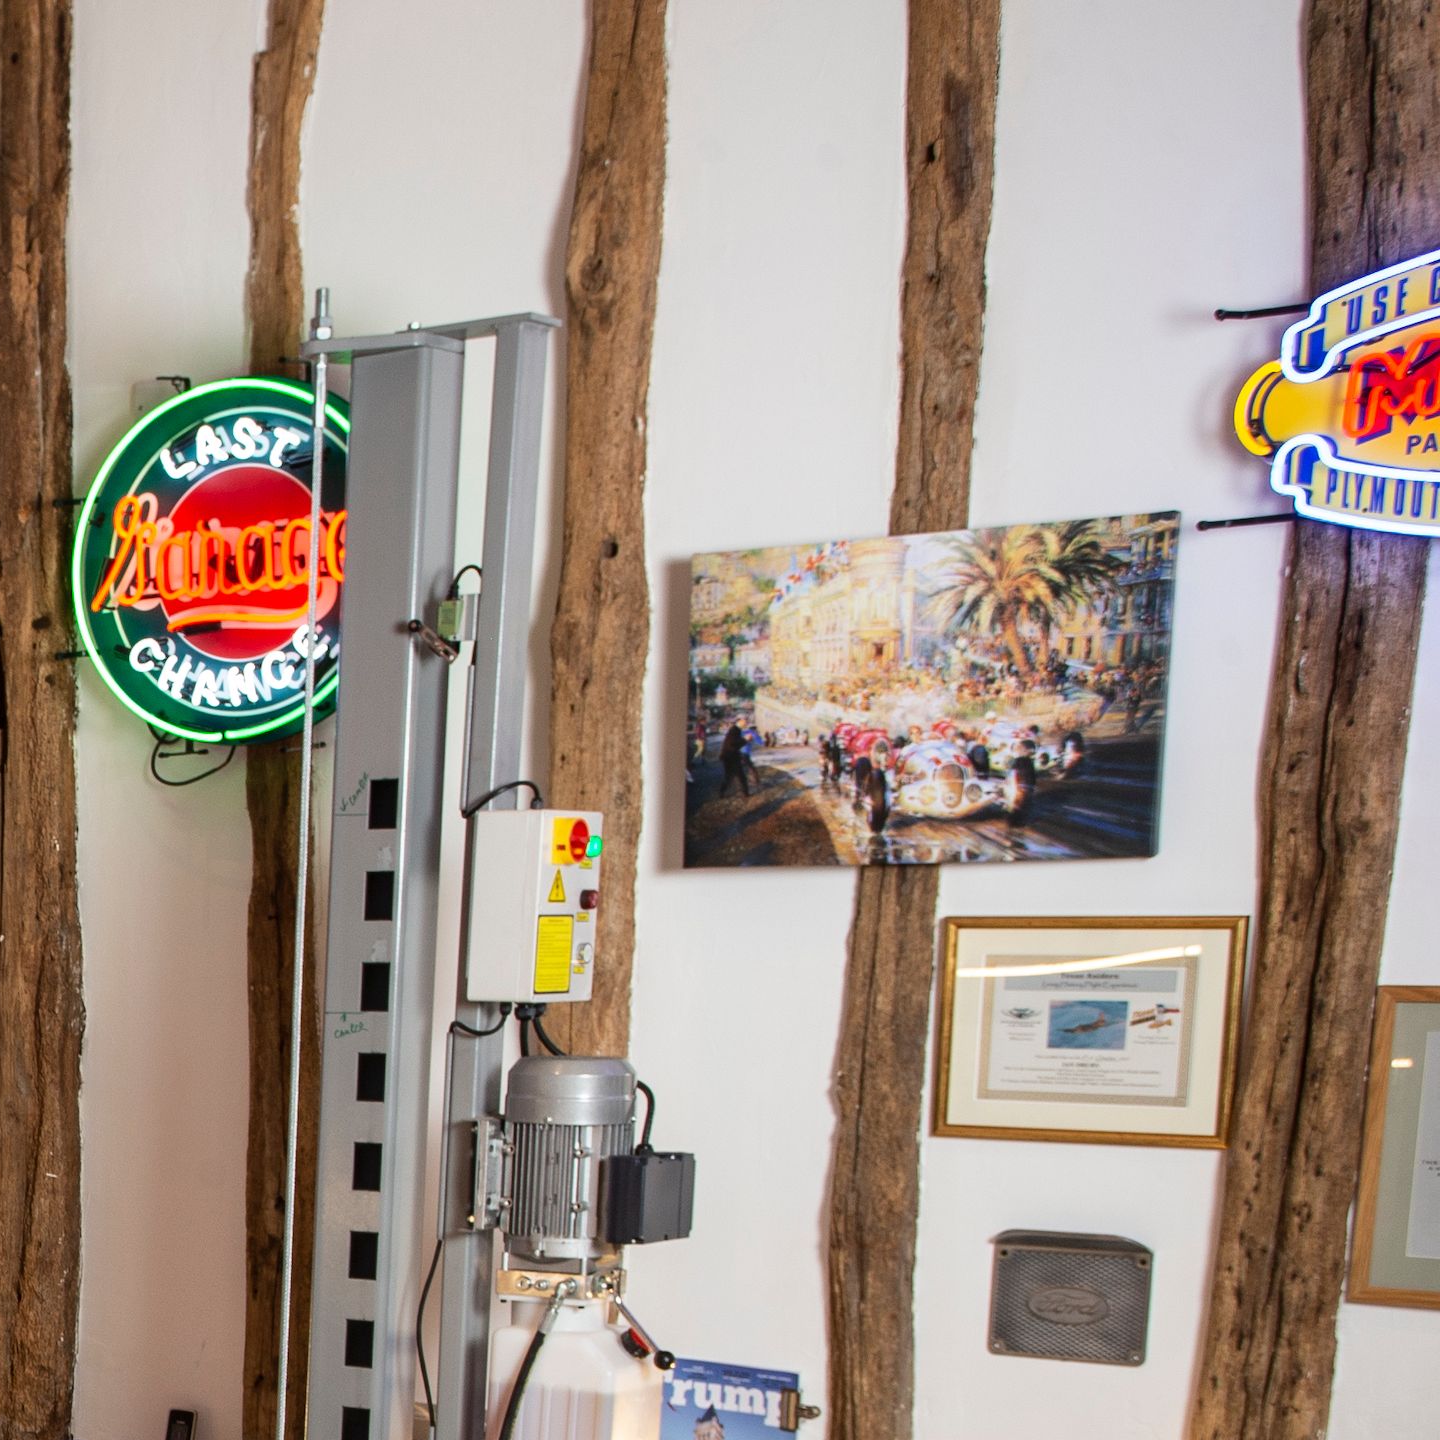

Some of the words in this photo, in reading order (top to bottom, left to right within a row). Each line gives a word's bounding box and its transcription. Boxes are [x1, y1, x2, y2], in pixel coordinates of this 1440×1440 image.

[1347, 277, 1409, 335] USE
[160, 417, 301, 479] LAST
[129, 624, 328, 706] CHANCE
[1036, 1292, 1101, 1320] Ford
